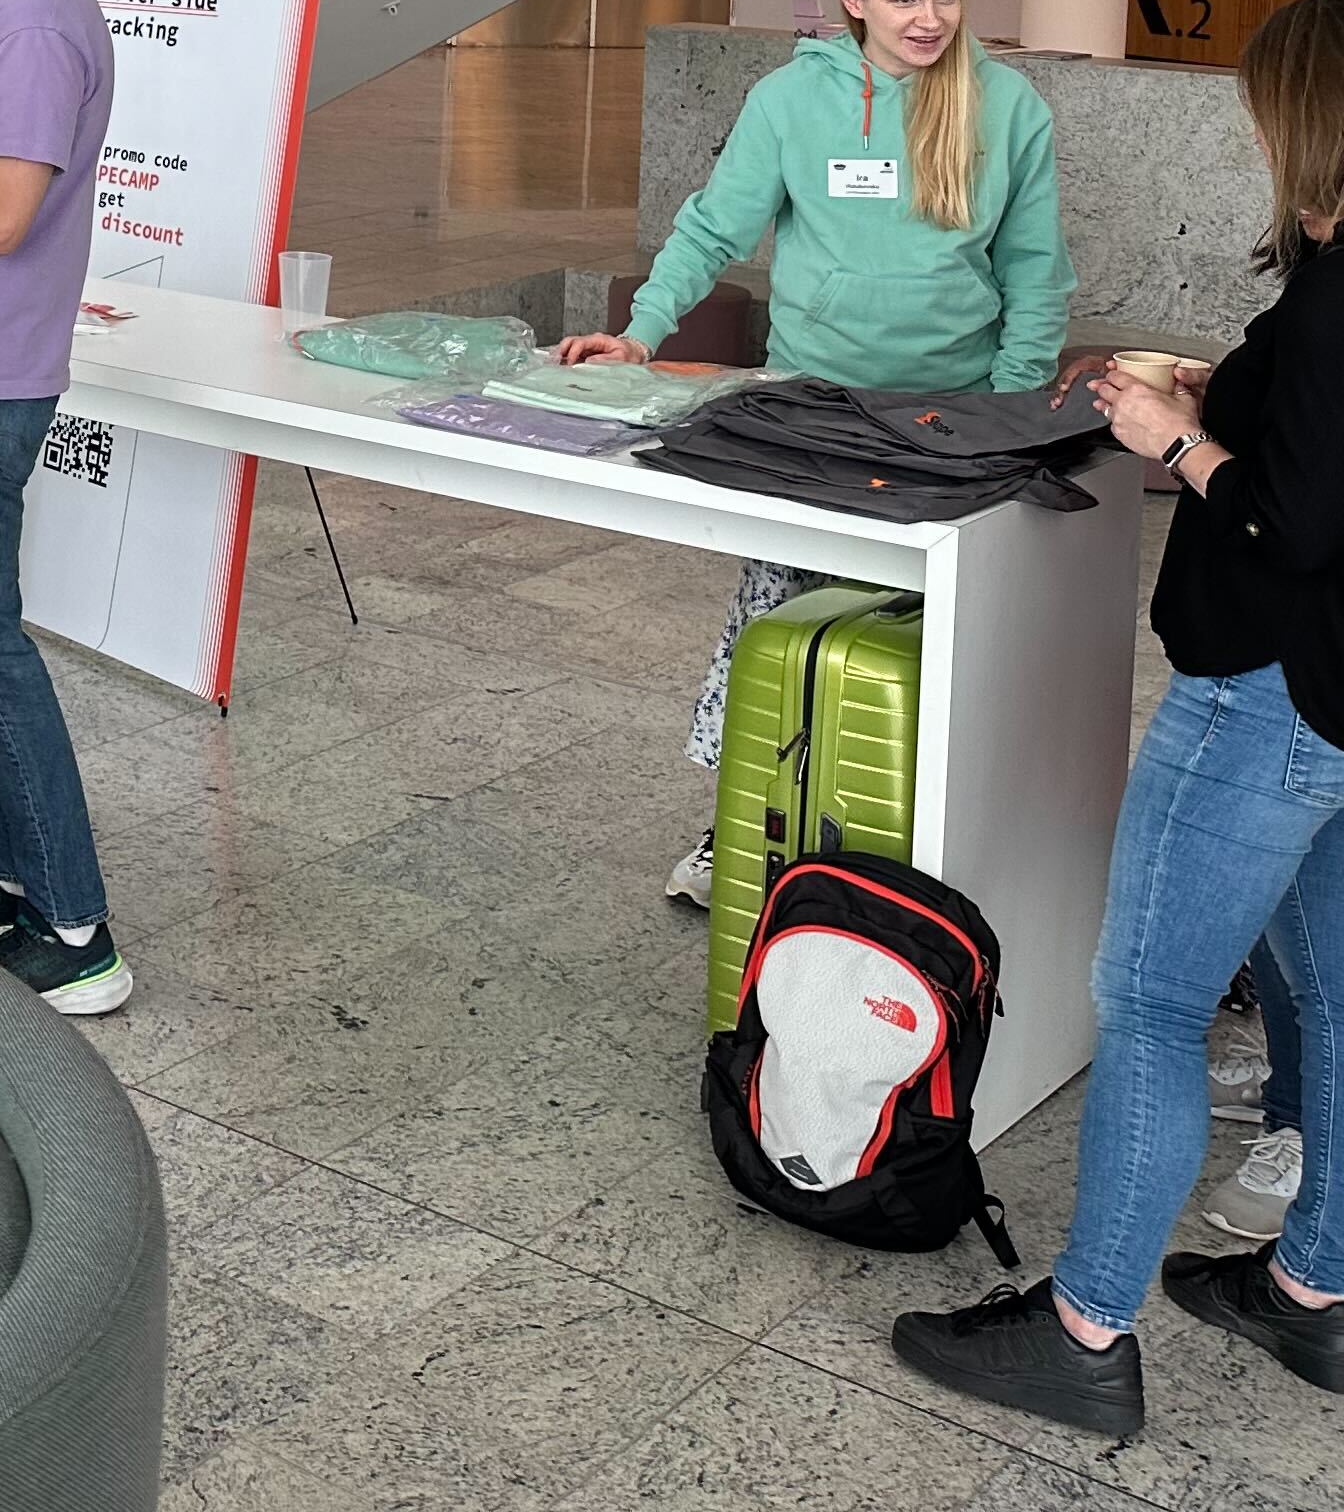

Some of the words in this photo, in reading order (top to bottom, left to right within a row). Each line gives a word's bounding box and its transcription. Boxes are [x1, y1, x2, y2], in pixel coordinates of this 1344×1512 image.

[105, 16, 179, 47] acking
[103, 146, 145, 164] promo
[154, 153, 188, 172] code
[96, 164, 160, 191] PECAMP
[98, 192, 125, 208] get
[102, 212, 184, 247] discount
